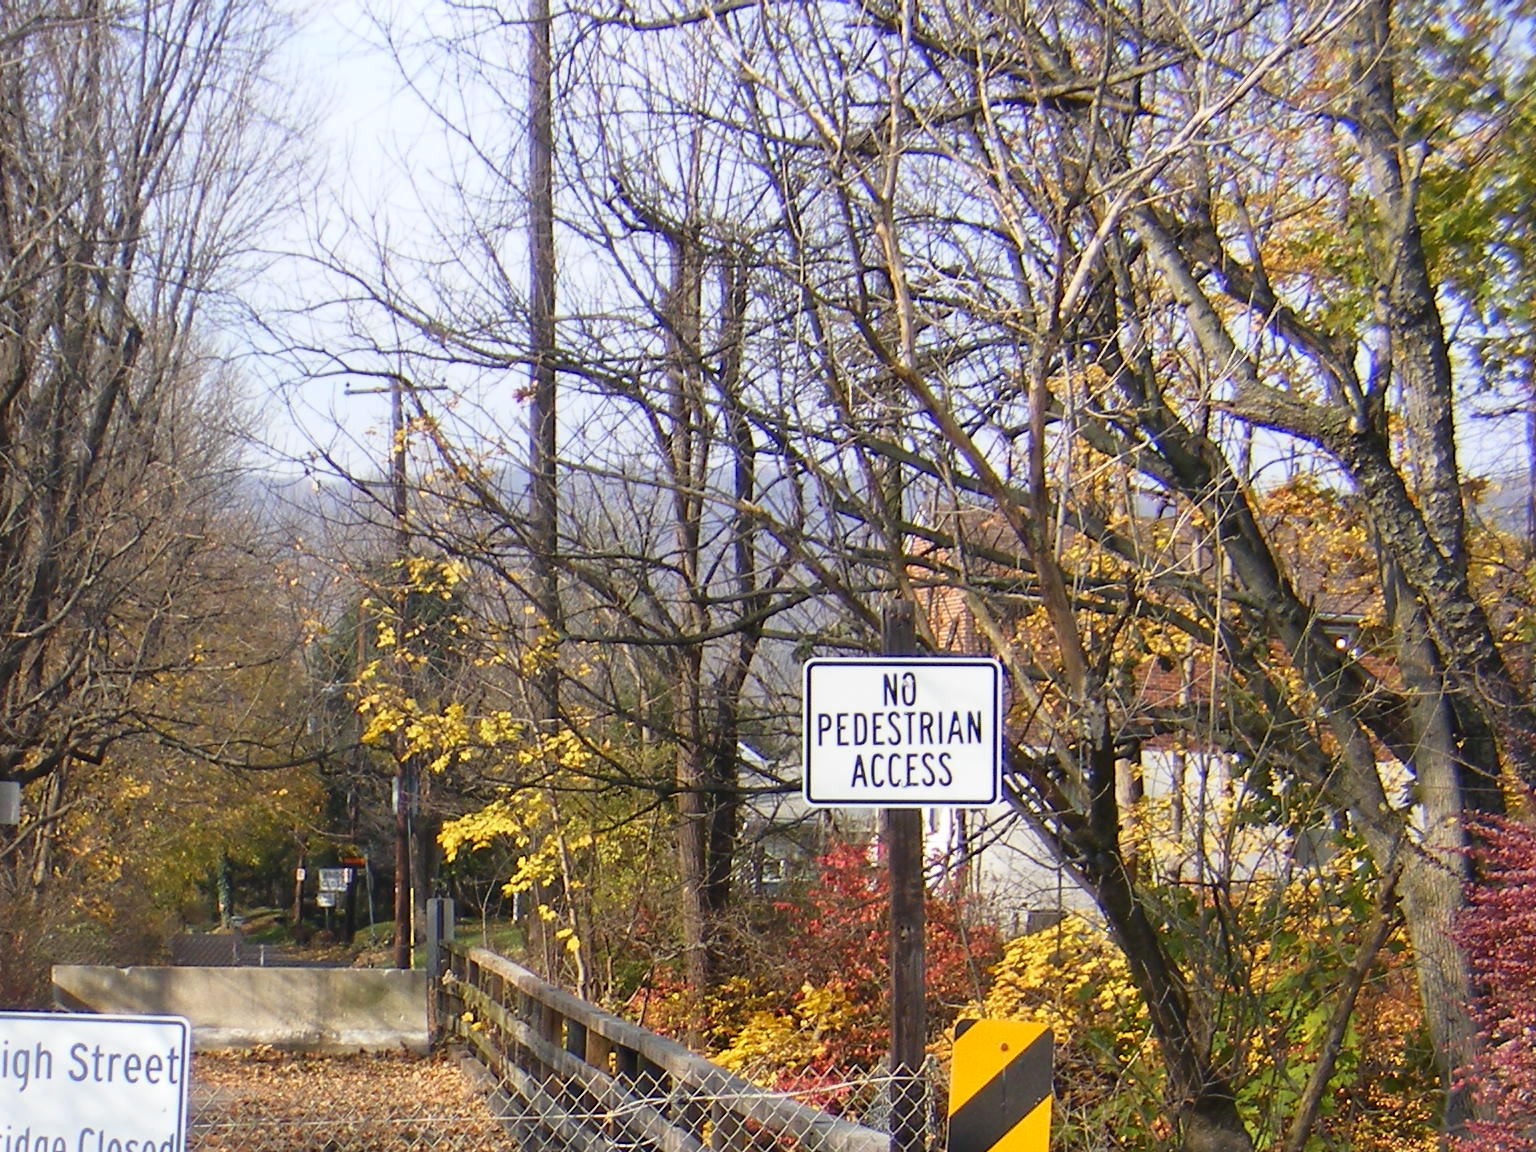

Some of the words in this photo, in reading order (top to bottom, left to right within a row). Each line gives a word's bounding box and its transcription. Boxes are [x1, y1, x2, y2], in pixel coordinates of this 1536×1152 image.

[883, 672, 917, 707] NO
[817, 710, 983, 746] PEDESTRIAN
[851, 752, 953, 788] ACCESS
[68, 1042, 180, 1084] Street
